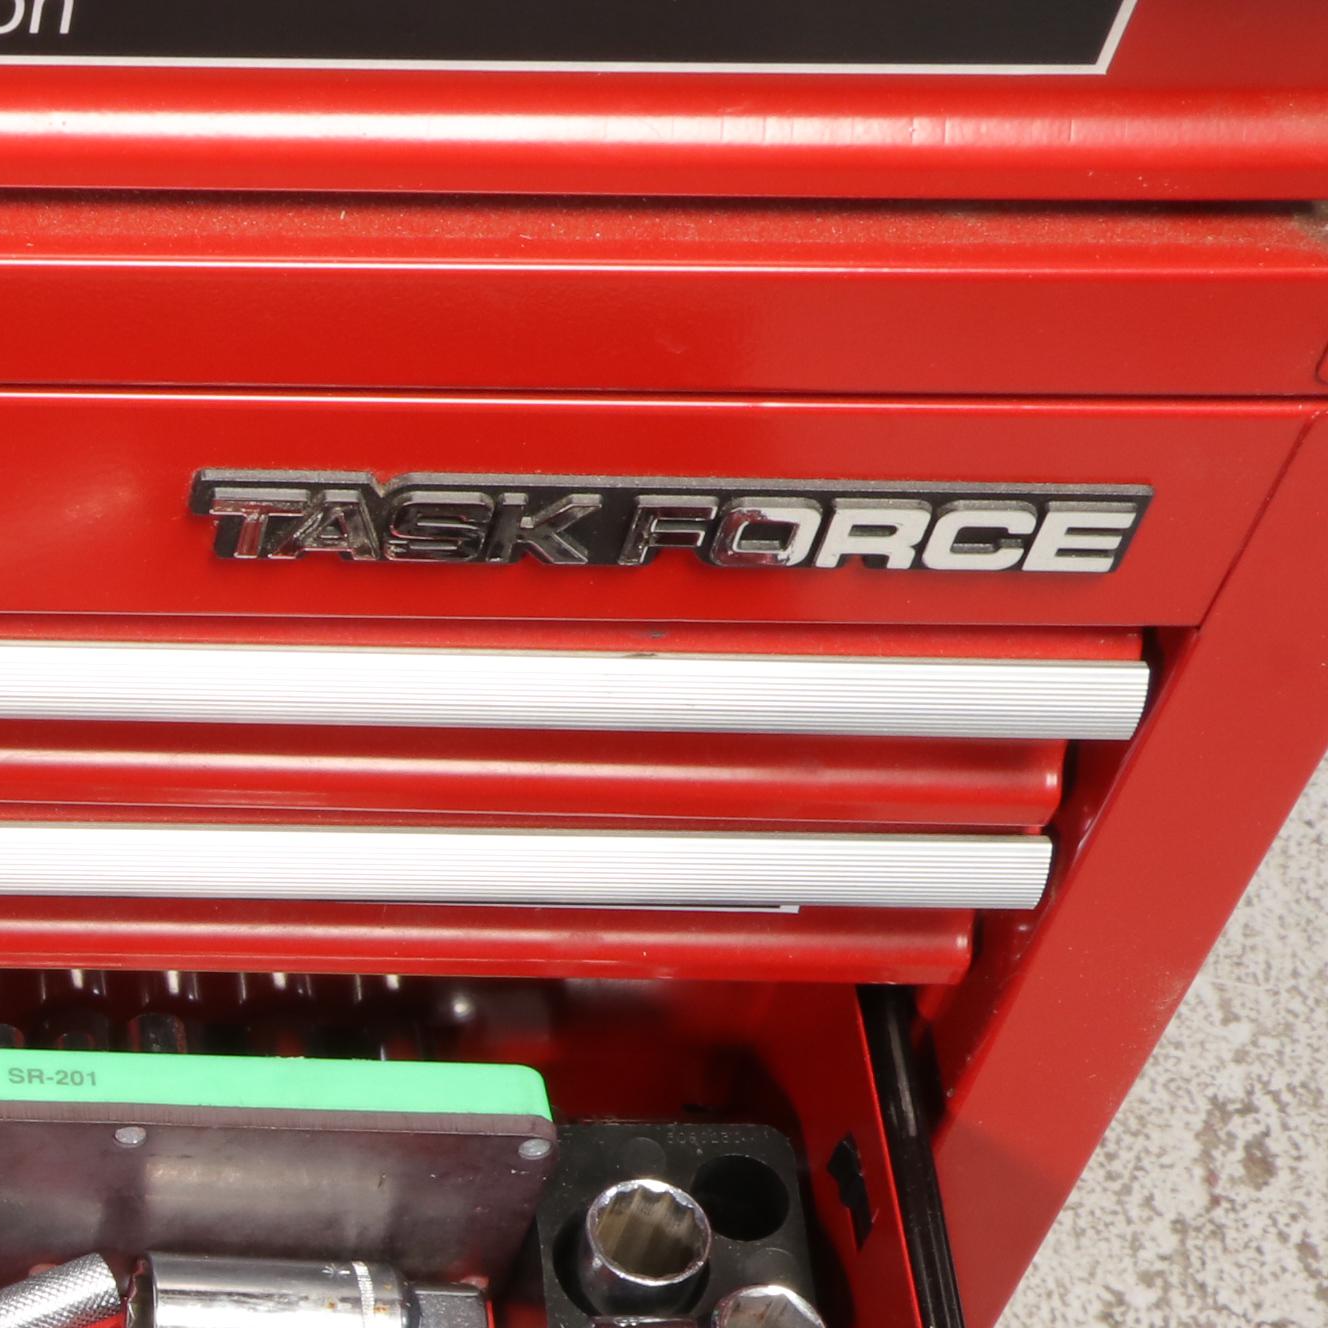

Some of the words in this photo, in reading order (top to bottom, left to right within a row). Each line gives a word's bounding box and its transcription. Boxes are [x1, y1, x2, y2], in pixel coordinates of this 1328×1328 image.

[210, 487, 603, 567] TASK
[617, 493, 1140, 575] FORCE
[8, 1066, 98, 1087] SR-201
